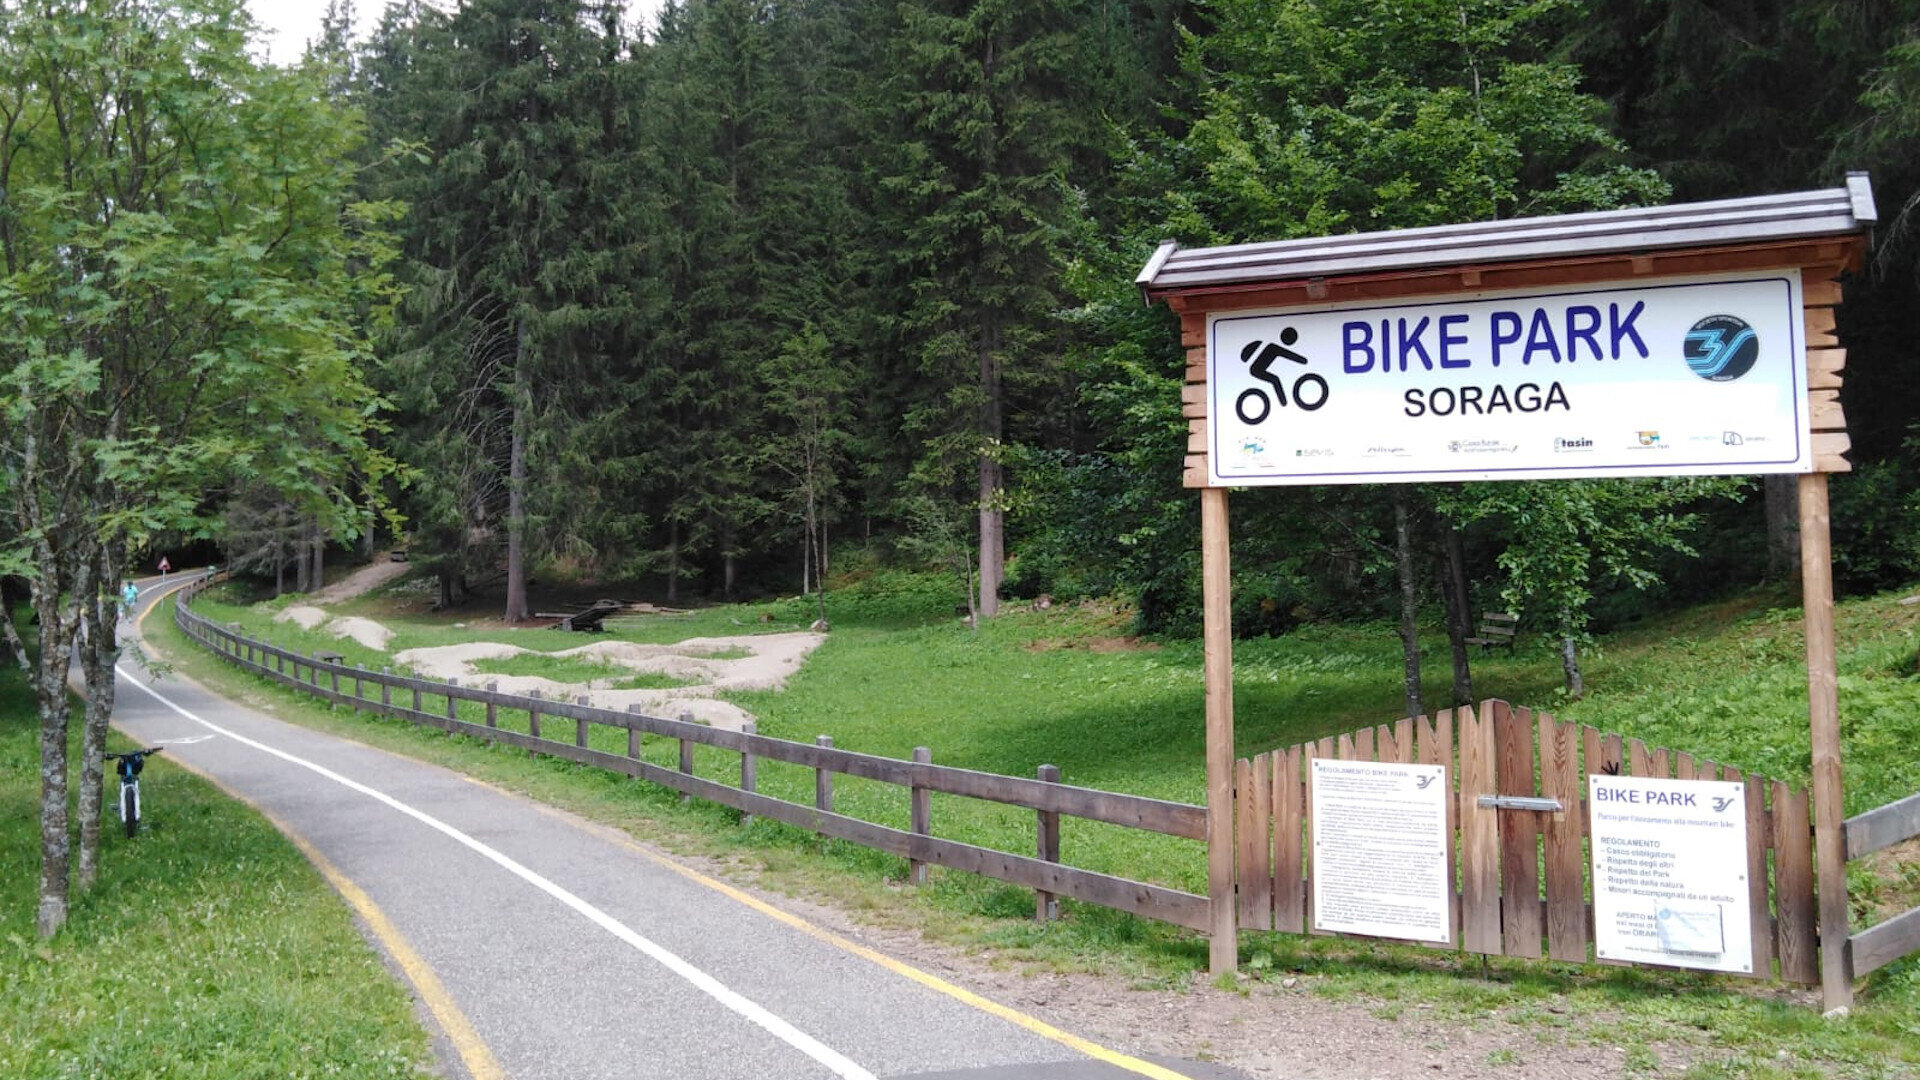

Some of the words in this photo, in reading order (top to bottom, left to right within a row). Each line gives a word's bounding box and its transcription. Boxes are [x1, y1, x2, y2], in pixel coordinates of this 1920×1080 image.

[1342, 314, 1472, 374] BIKE
[1490, 300, 1650, 367] PARK
[1404, 381, 1571, 417] SORAGA
[1561, 437, 1593, 448] tasin
[1596, 787, 1640, 804] BIKE
[1646, 790, 1697, 807] PARK
[1687, 819, 1719, 828] mountain
[1720, 820, 1735, 829] bike
[1600, 837, 1660, 848] REGOLAMENTO
[1606, 847, 1629, 856] Casco
[1631, 849, 1676, 859] obbligatorio
[1607, 856, 1638, 867] Rispetto
[1639, 859, 1657, 869] degli
[1659, 861, 1674, 869] altri
[1607, 866, 1638, 877] Rispetto
[1640, 868, 1651, 877] del
[1653, 869, 1670, 878] Park
[1608, 875, 1639, 886] Rispetto
[1640, 878, 1658, 888] della
[1660, 880, 1684, 889] natura
[1608, 886, 1631, 895] Minori
[1633, 889, 1686, 900] accompagnati
[1687, 892, 1697, 900] da
[1710, 894, 1735, 903] adulto
[1616, 912, 1646, 921] APERTO
